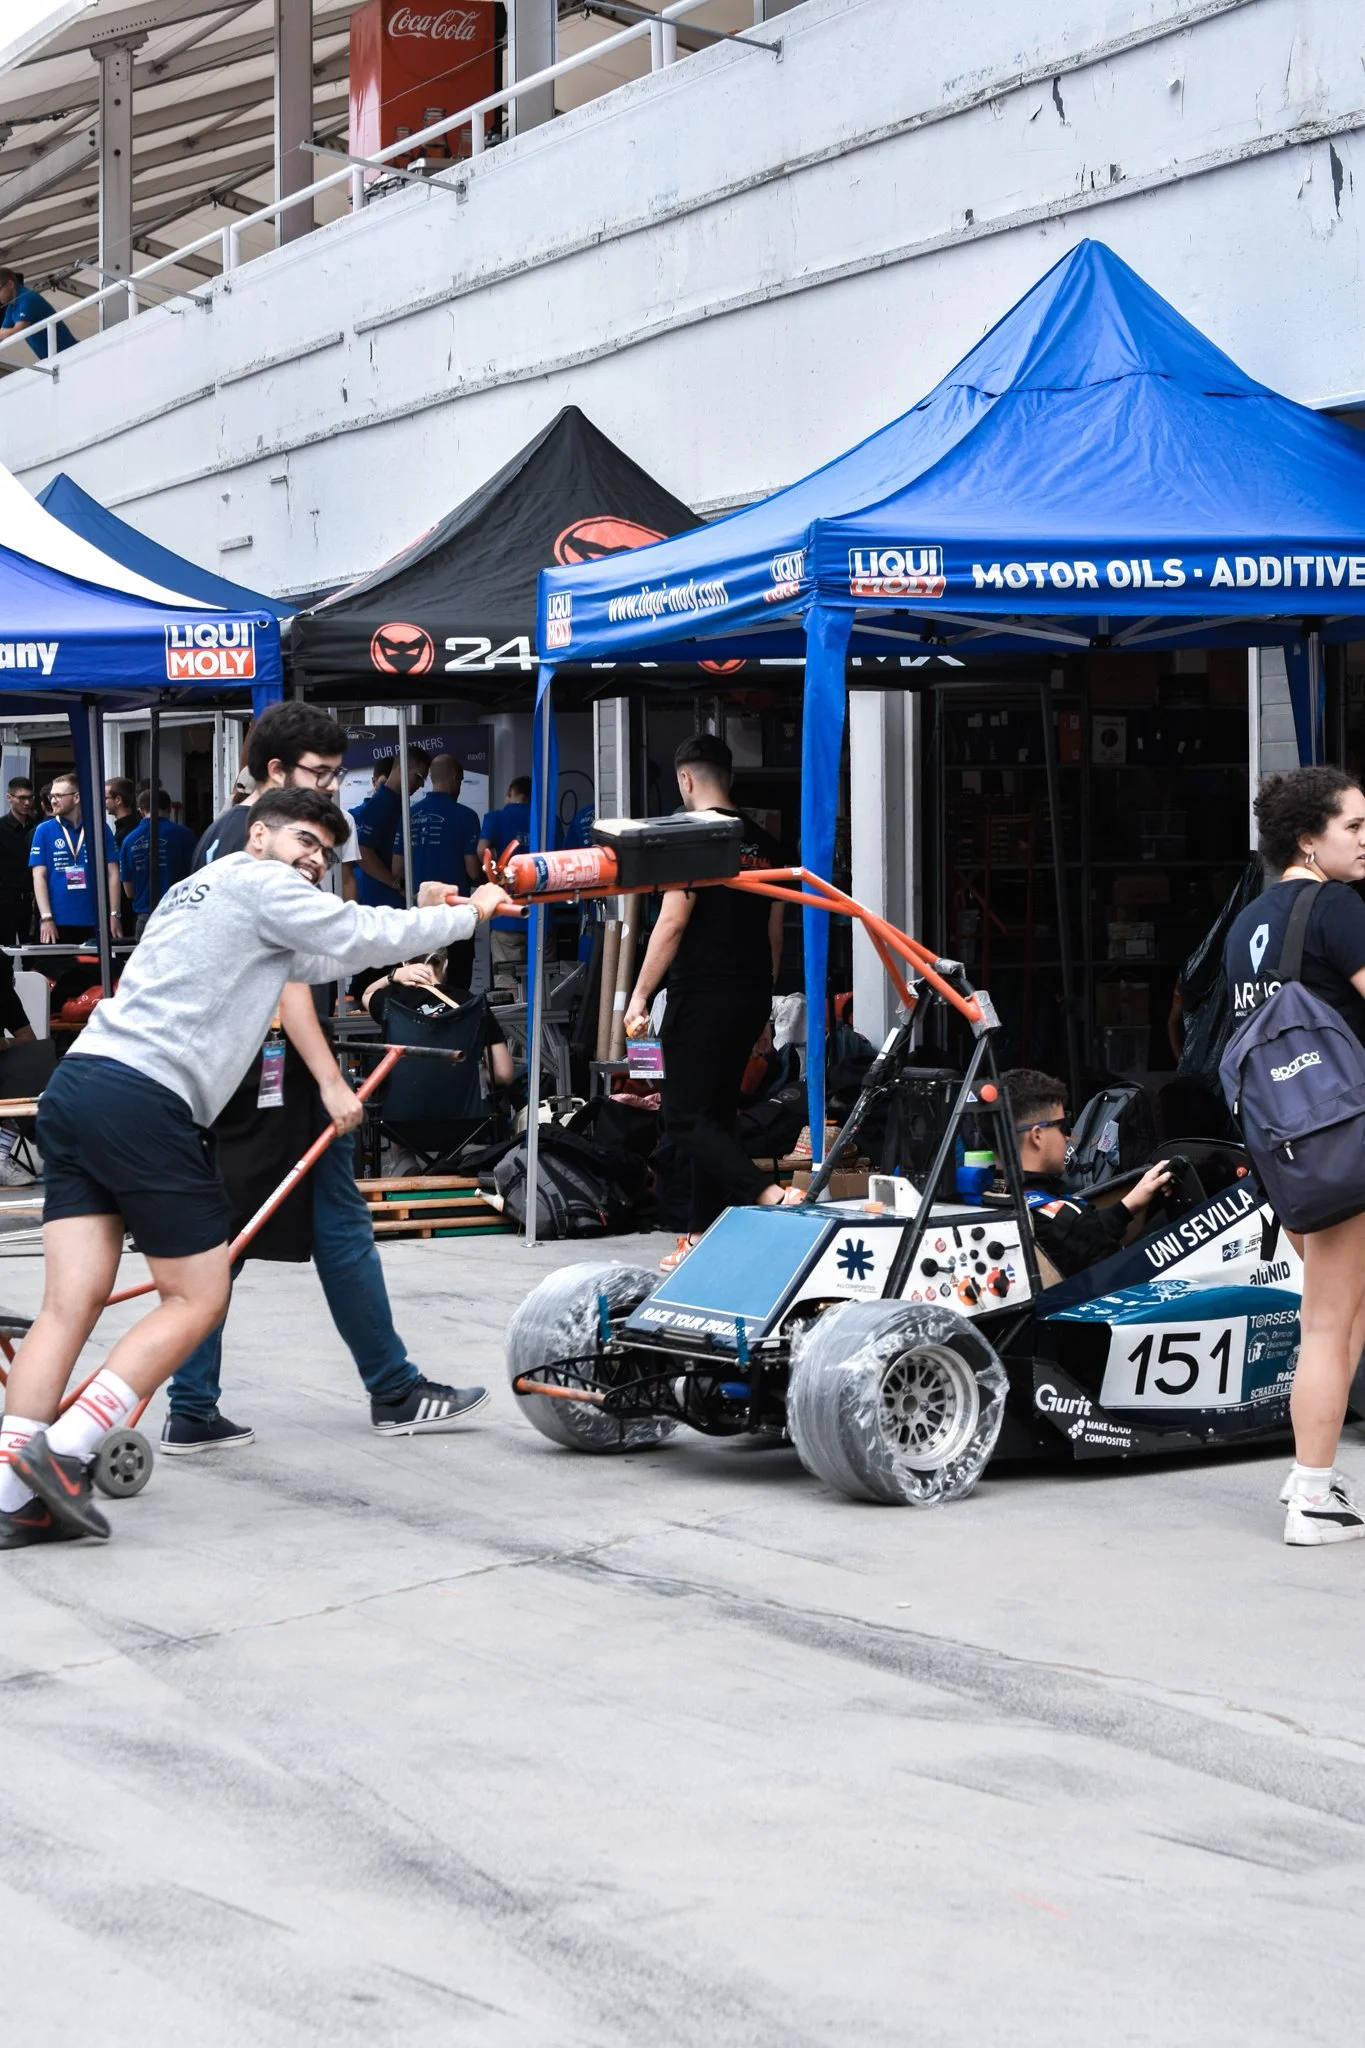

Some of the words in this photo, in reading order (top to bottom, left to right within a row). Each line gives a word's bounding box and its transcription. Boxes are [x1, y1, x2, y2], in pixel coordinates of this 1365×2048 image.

[388, 7, 481, 41] Coca-Cola
[854, 550, 937, 577] LIQUI
[972, 561, 1099, 589] MOTOR
[1107, 559, 1185, 588] OILS
[1210, 556, 1365, 587] ADDITIVE
[856, 577, 940, 594] MOLY
[548, 593, 572, 620] LIQUI
[608, 578, 729, 623] www.liqui-moly.com
[170, 622, 249, 649] LIQUI
[548, 620, 572, 647] MOLY
[0, 642, 59, 675] any
[170, 650, 251, 676] MOLY
[372, 745, 393, 760] OUR
[394, 737, 444, 755] PNERS
[1270, 1051, 1320, 1080] sparco
[1144, 1232, 1185, 1268] UNI
[1179, 1188, 1255, 1248] SEVILLA
[639, 1307, 669, 1322] RACE
[674, 1311, 704, 1330] YOUR
[1127, 1328, 1232, 1396] 151
[1035, 1383, 1093, 1416] Gurit
[1086, 1420, 1108, 1432] MAKE
[1084, 1433, 1131, 1448] COMPOSITES
